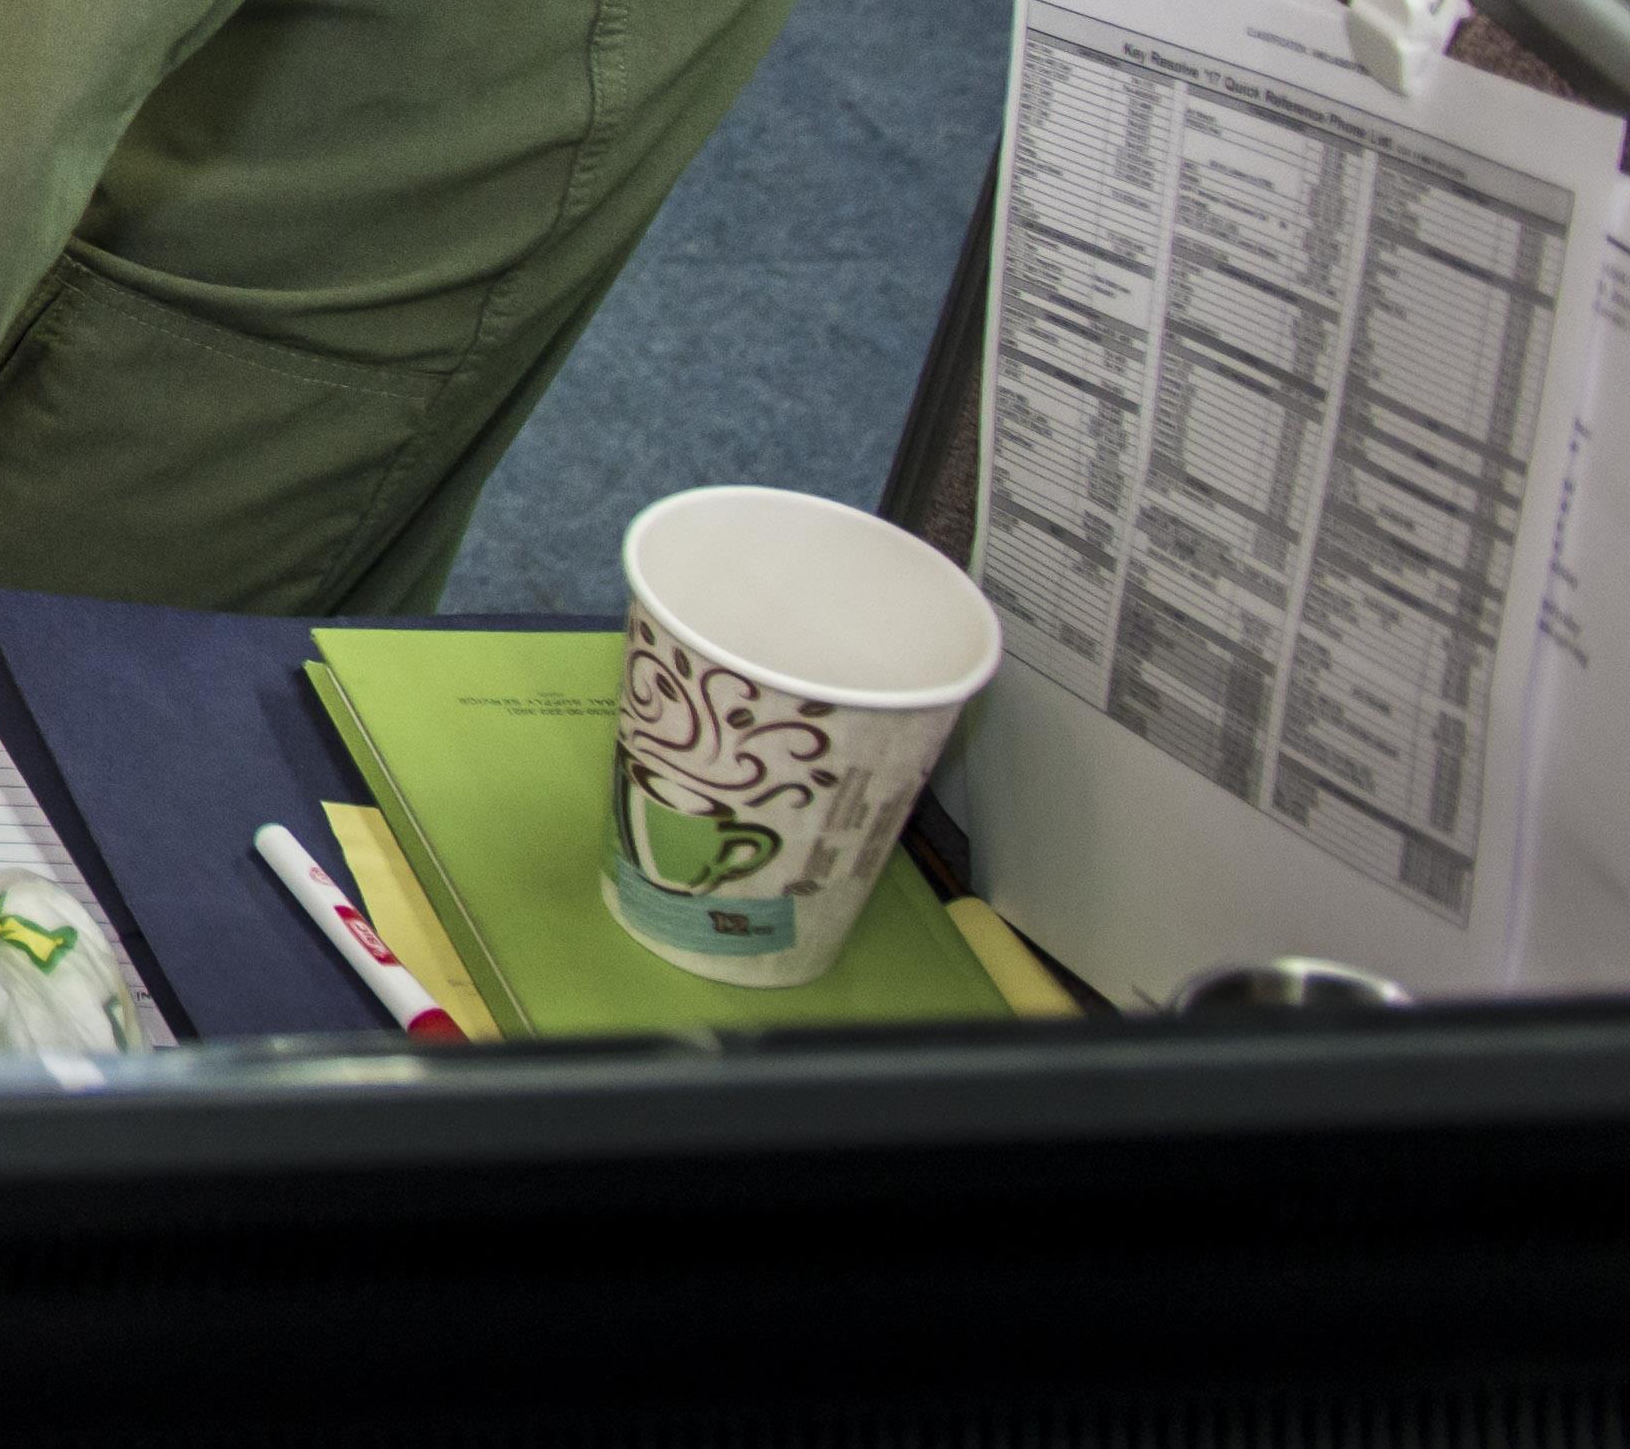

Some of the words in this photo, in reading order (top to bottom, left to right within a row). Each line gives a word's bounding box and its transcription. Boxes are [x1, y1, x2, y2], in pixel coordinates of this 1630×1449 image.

[1123, 43, 1145, 63] Key
[1150, 50, 1199, 78] Resolve
[1225, 76, 1259, 100] Quick
[1329, 113, 1367, 139] Phone
